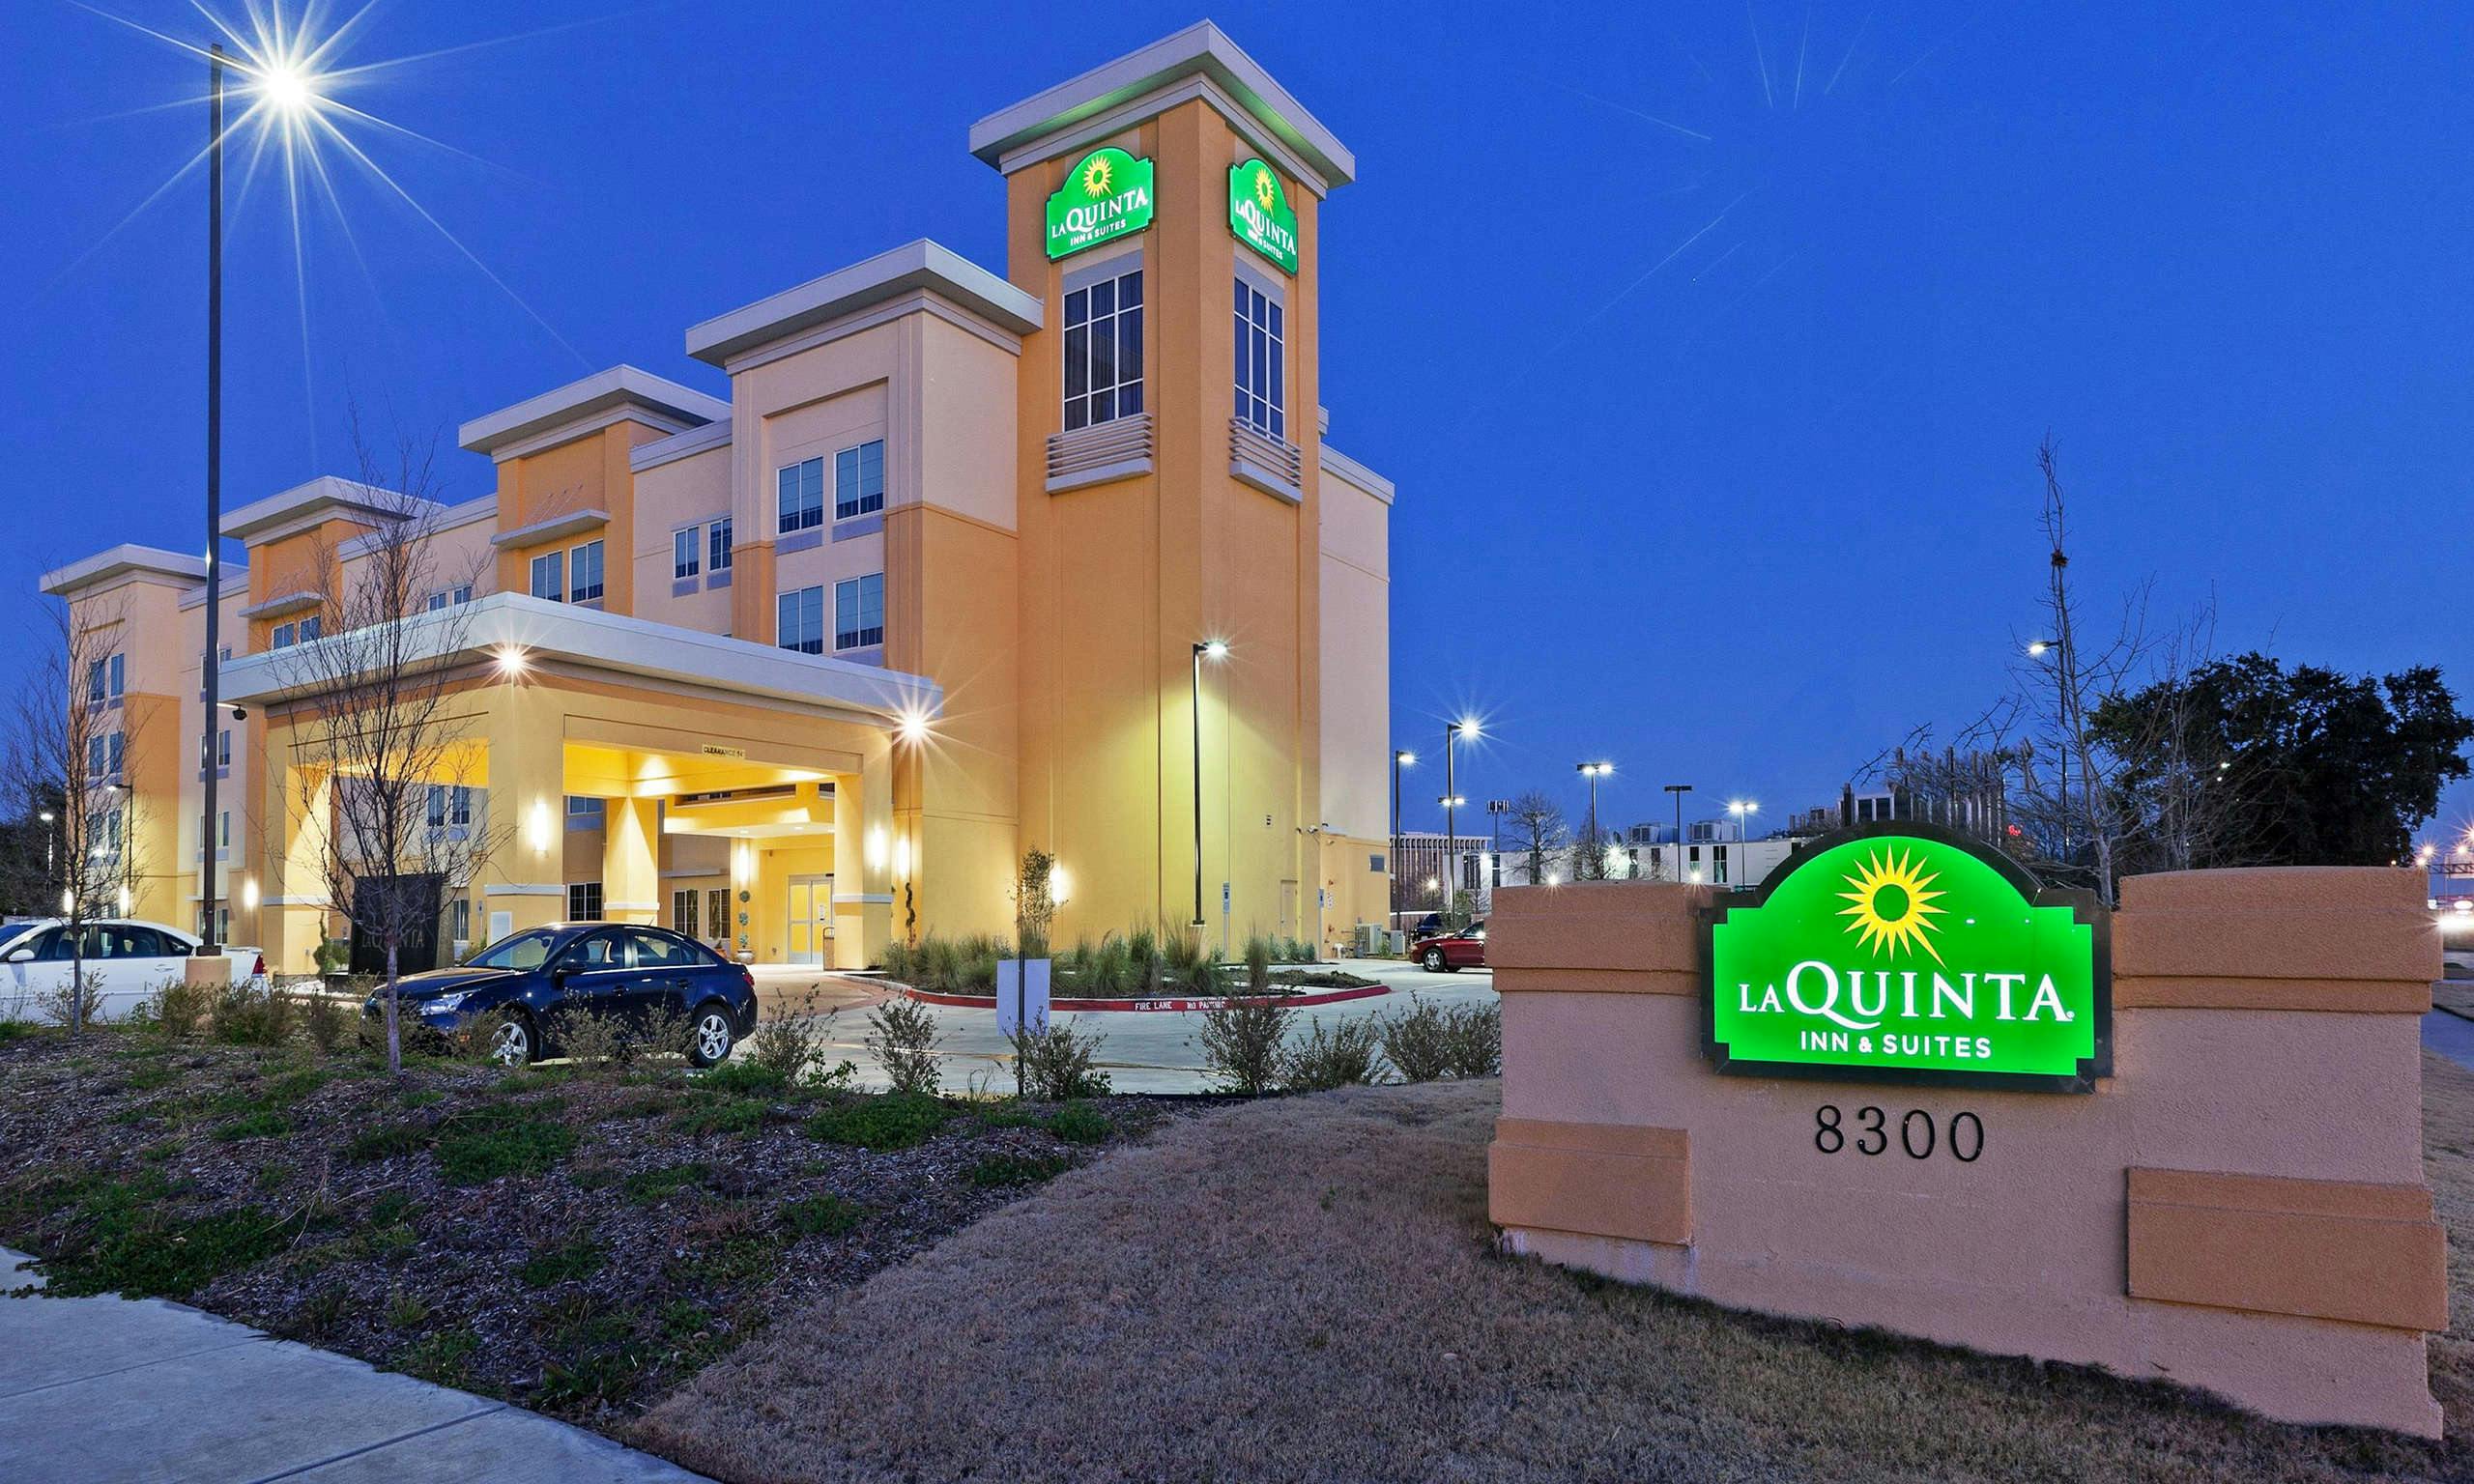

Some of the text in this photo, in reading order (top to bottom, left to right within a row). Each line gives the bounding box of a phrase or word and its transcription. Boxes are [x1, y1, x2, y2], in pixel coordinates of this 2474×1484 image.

[1051, 187, 1148, 239] LA QUINTA
[1070, 233, 1086, 246] INN
[1094, 218, 1126, 238] SUITES
[1235, 199, 1297, 256] LA QUINTA
[1135, 1002, 1151, 1011] FIRE
[1153, 1001, 1172, 1010] LANE
[1739, 960, 2073, 1030] LA QUINTA
[1800, 1031, 1992, 1059] INN & SUITES
[1815, 1104, 1984, 1162] 8300
